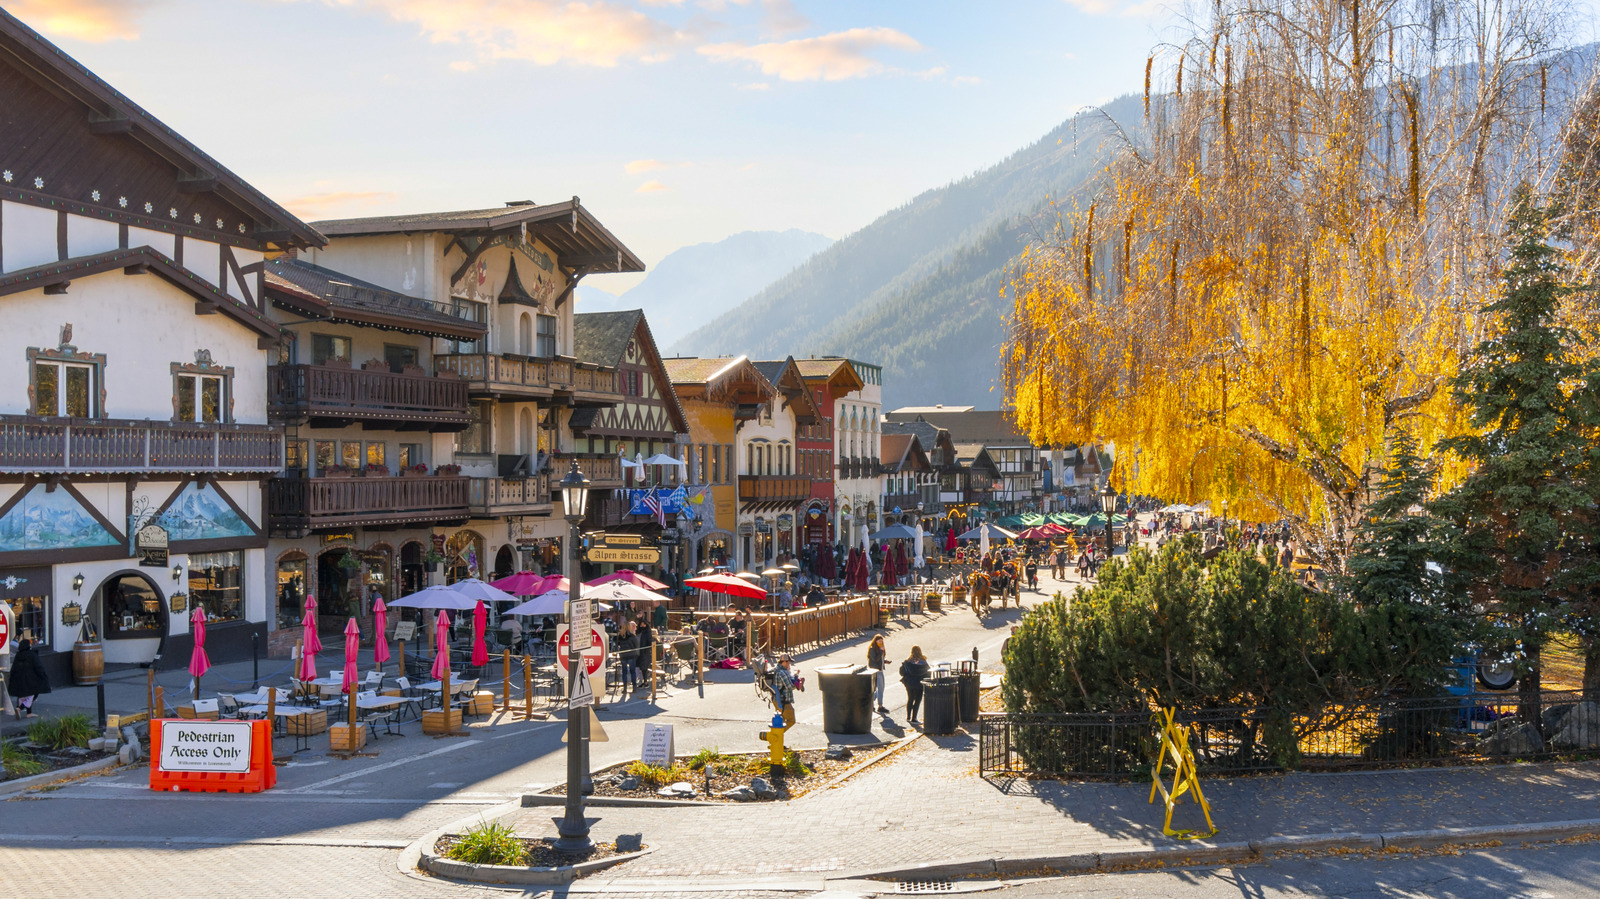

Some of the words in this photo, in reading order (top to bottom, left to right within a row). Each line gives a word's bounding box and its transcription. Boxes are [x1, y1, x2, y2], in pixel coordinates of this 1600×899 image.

[594, 550, 617, 560] Alpen
[620, 551, 652, 560] Strasse
[178, 730, 235, 743] Pedestrian
[170, 745, 208, 758] Access
[213, 746, 241, 760] Only
